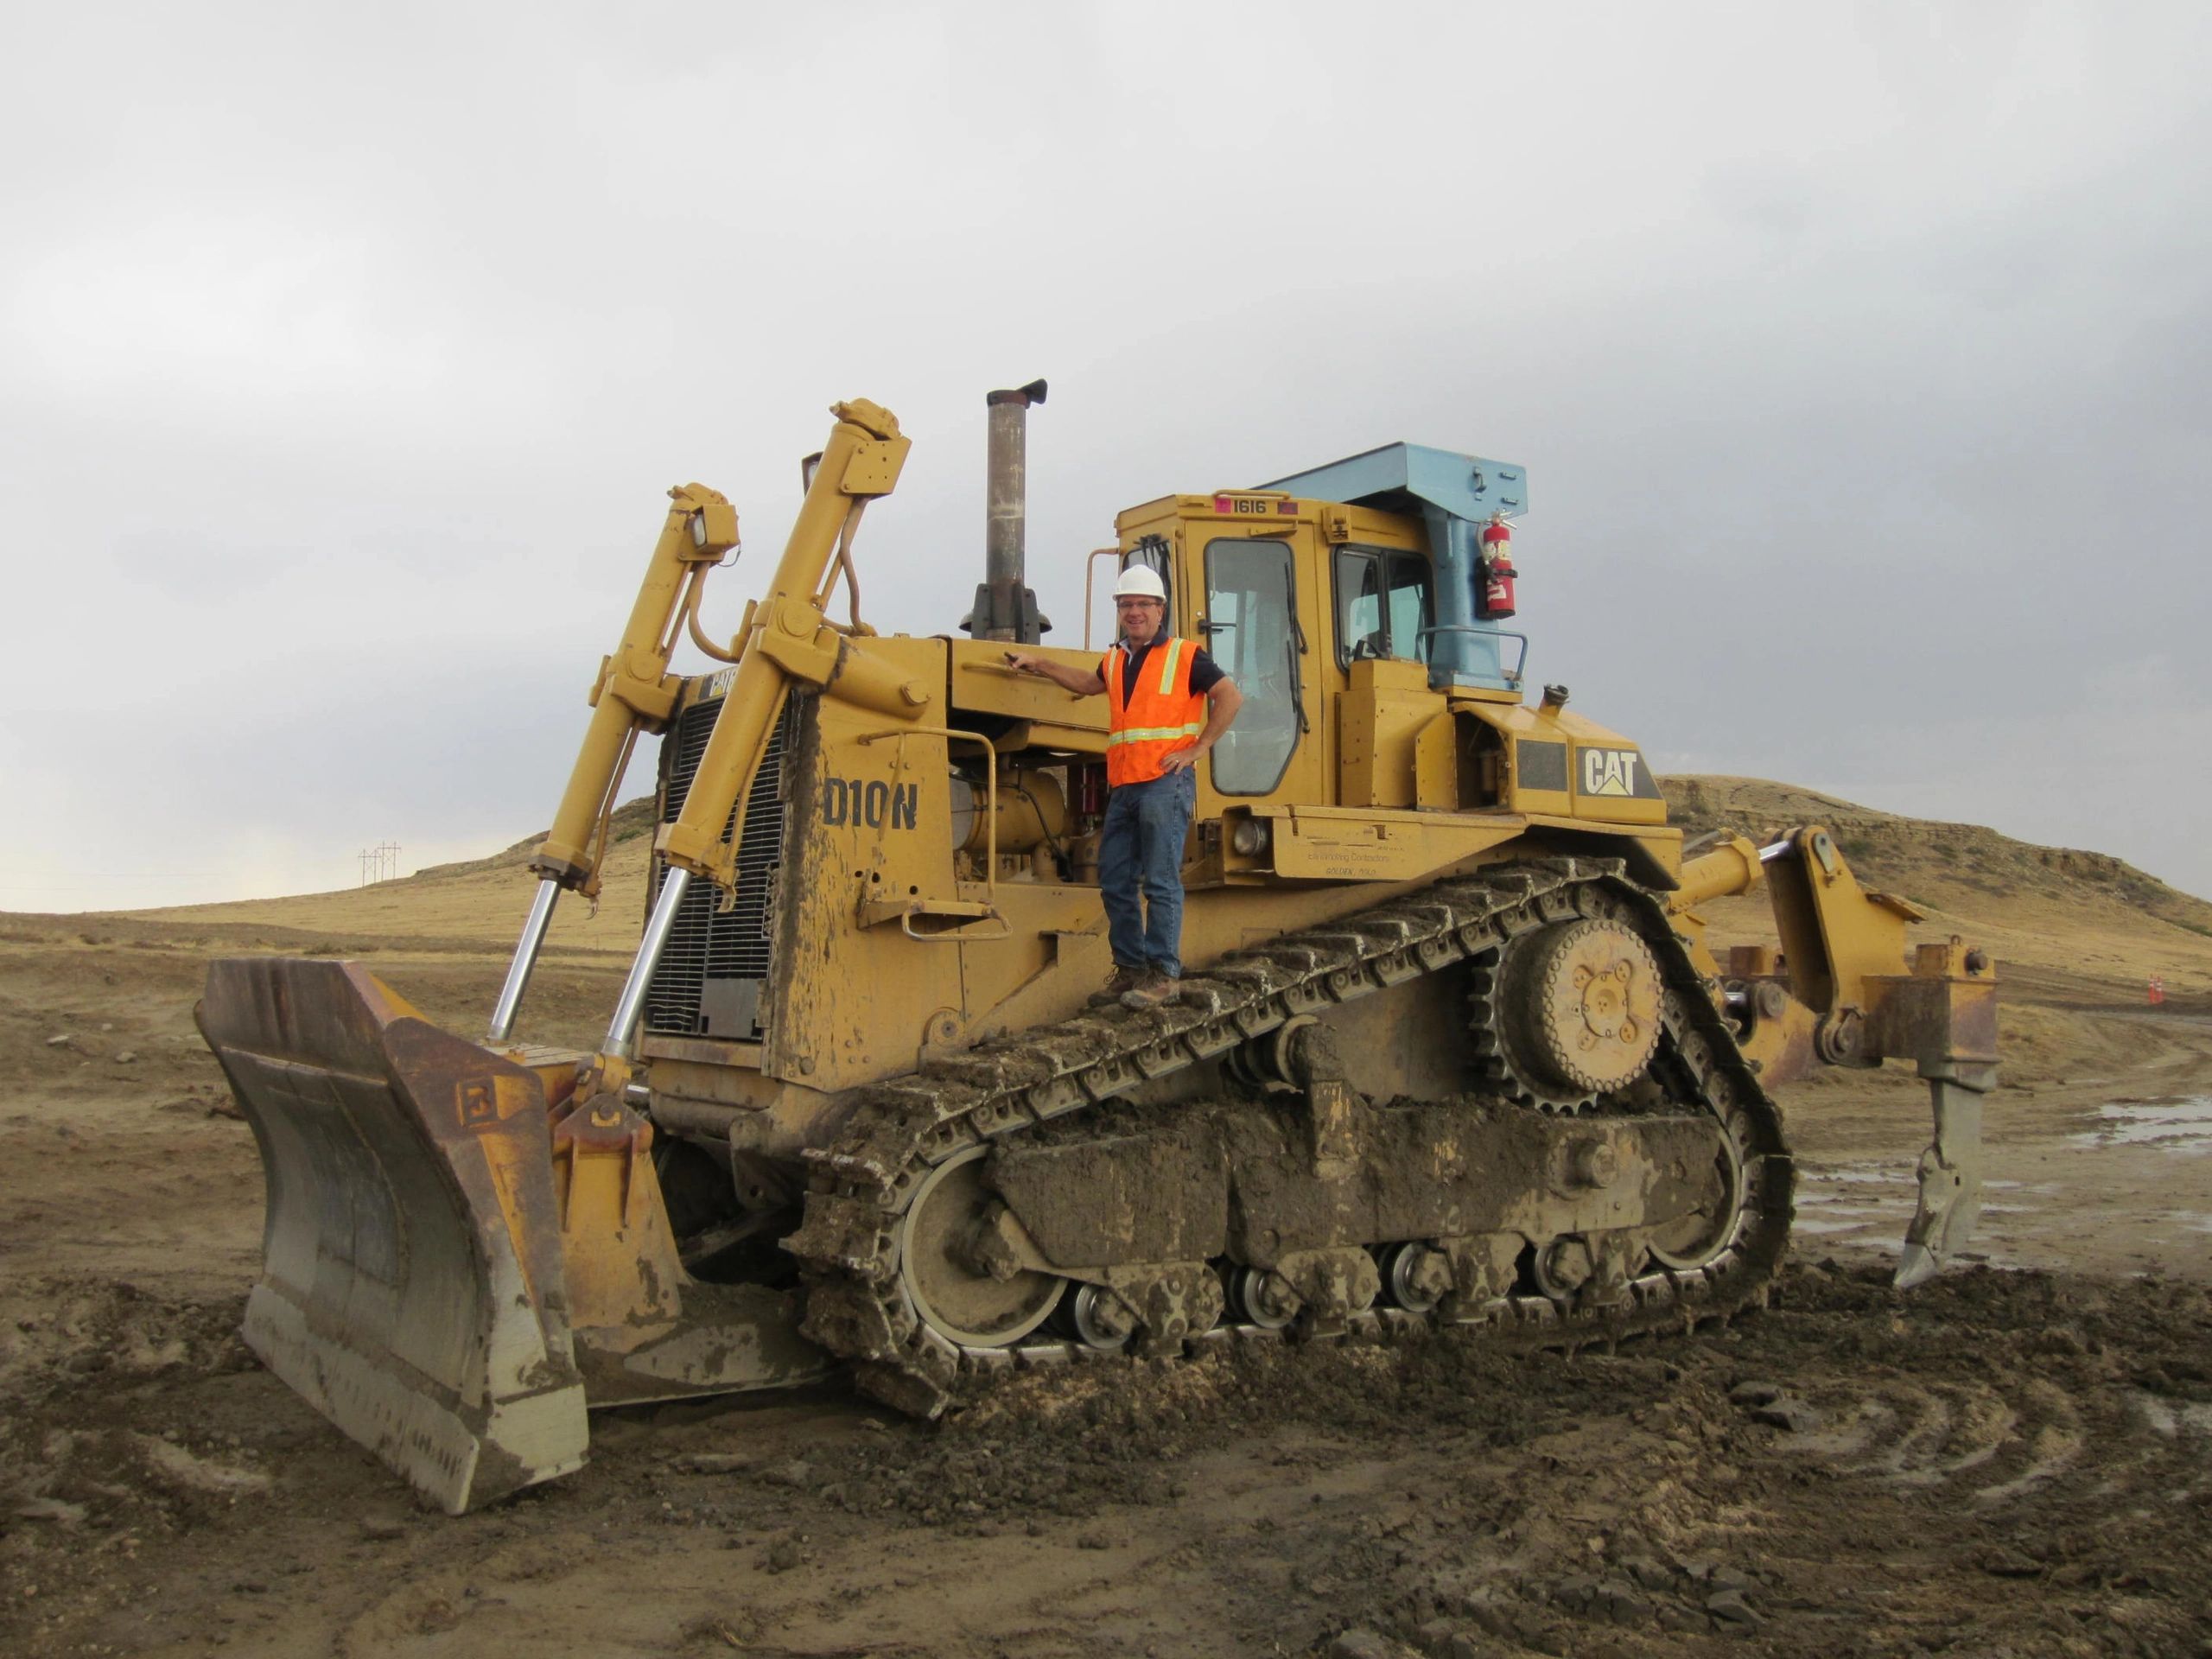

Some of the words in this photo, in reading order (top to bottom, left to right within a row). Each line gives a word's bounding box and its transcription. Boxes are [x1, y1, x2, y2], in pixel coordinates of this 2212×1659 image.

[1233, 499, 1267, 513] 1616
[1585, 749, 1637, 796] CAT
[823, 778, 918, 830] D10N
